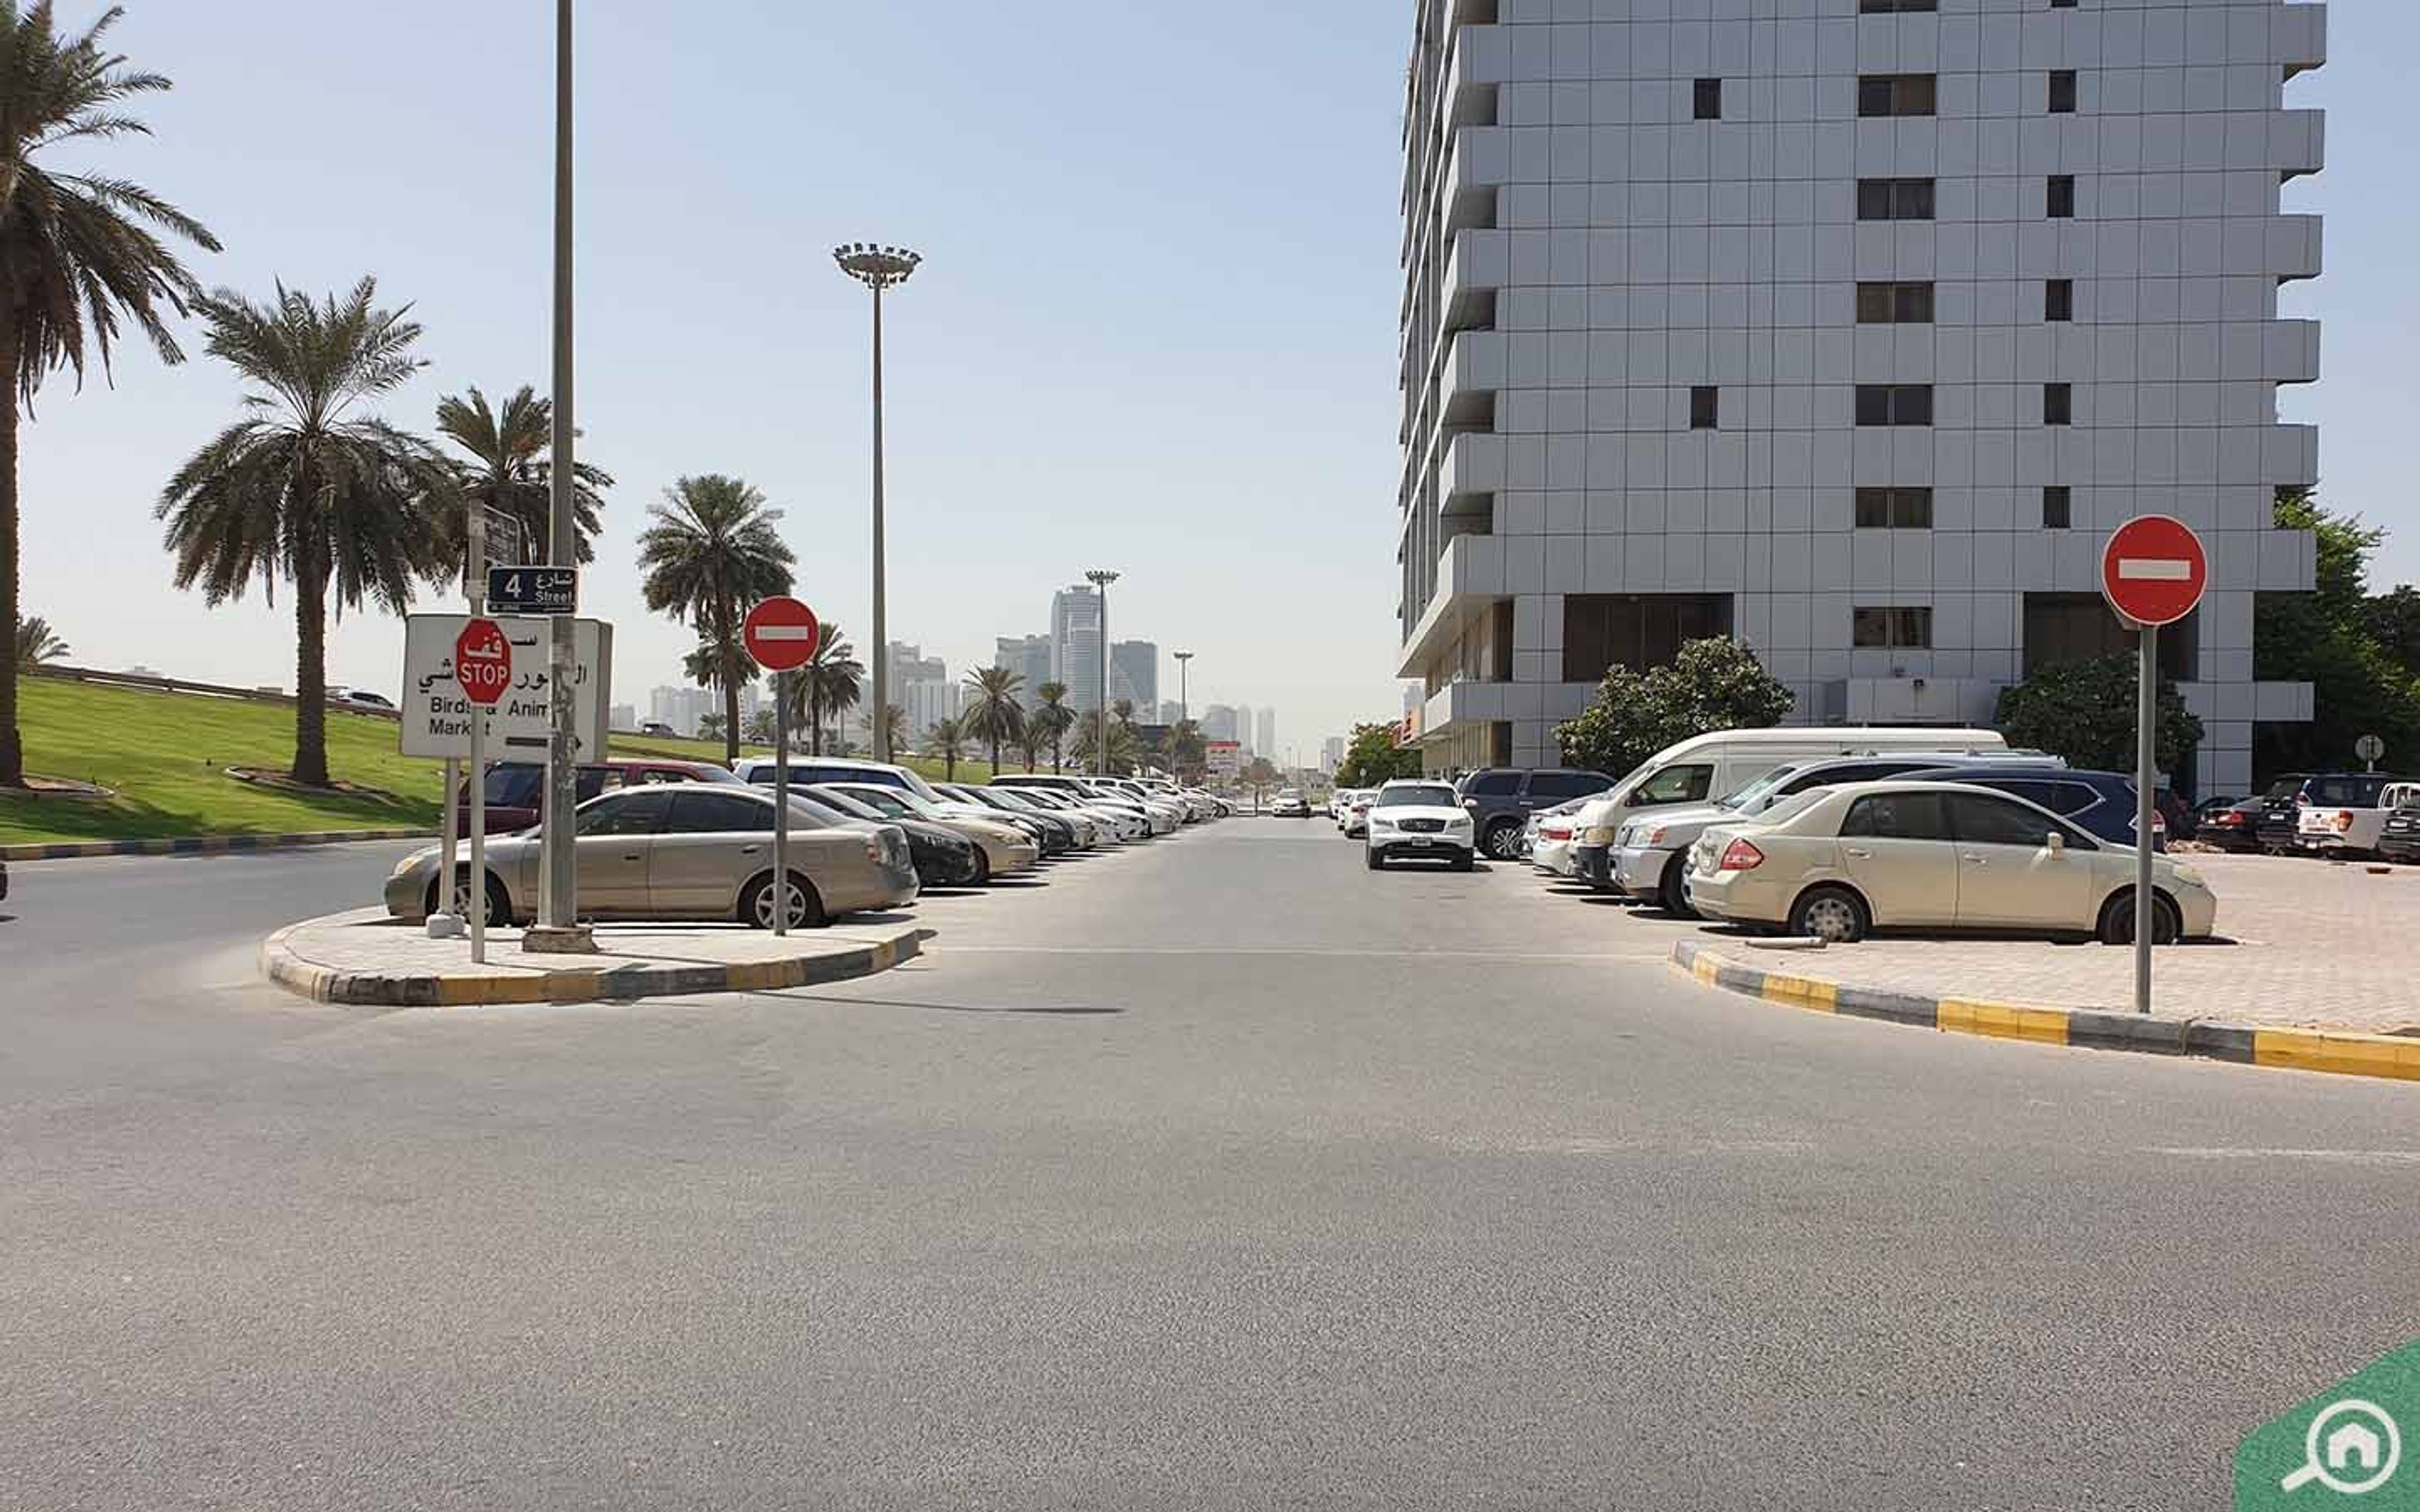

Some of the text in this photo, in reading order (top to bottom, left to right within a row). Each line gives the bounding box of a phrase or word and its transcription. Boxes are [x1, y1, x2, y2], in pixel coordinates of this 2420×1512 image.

[505, 574, 522, 598] 4
[536, 572, 572, 589] شارع
[536, 591, 572, 603] Street
[464, 631, 502, 658] قف
[460, 663, 508, 686] STOP
[429, 718, 491, 736] Markt
